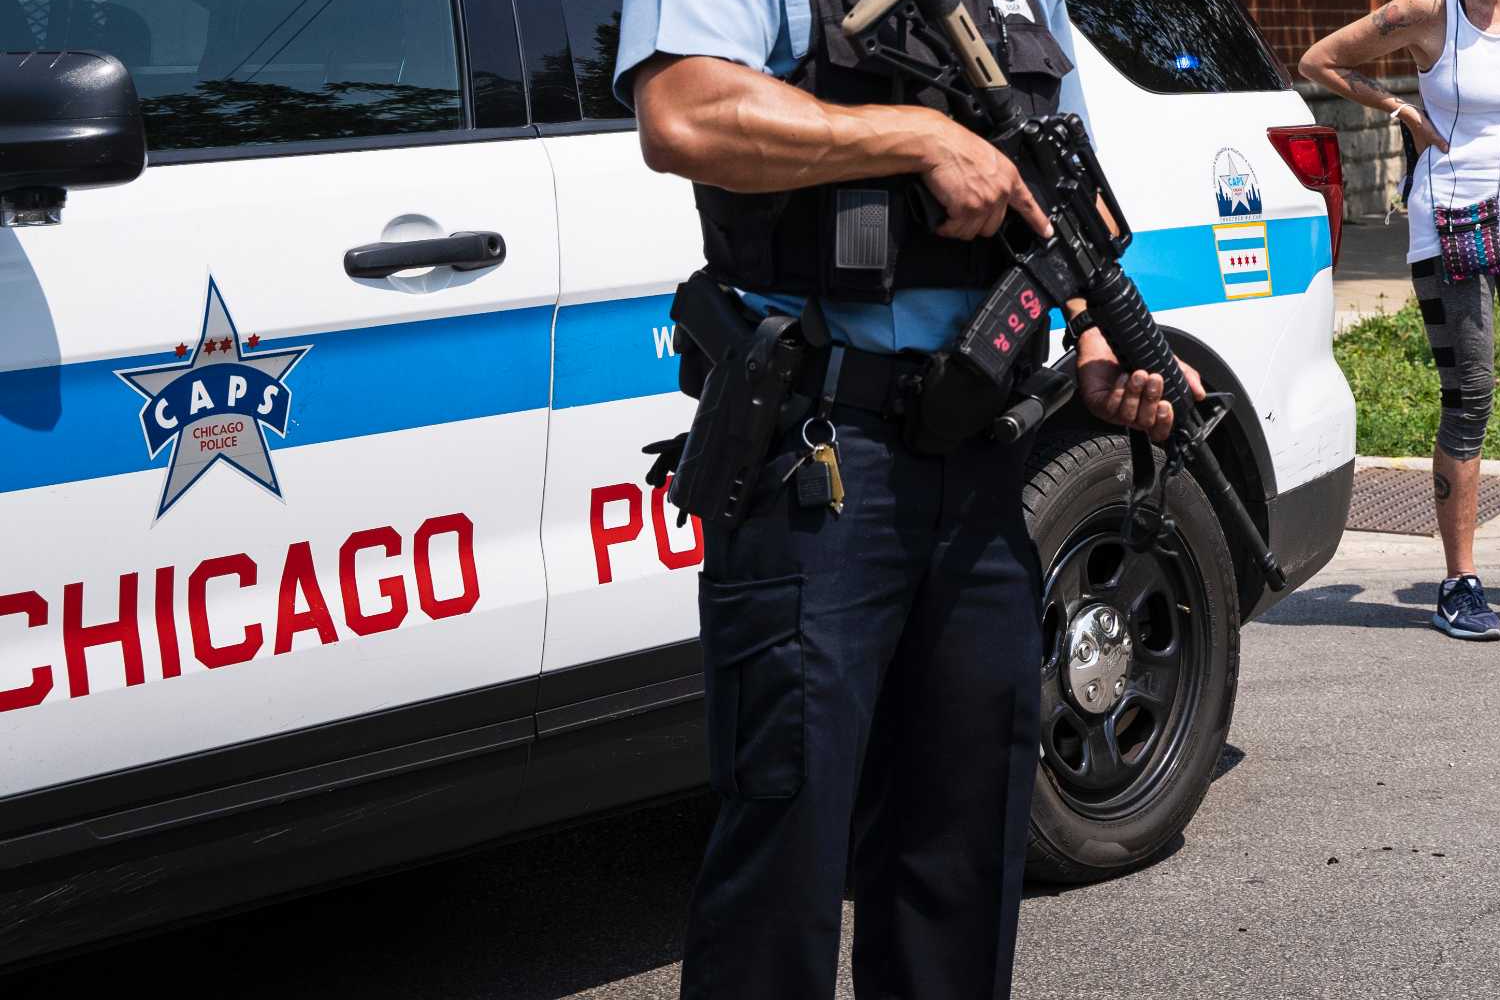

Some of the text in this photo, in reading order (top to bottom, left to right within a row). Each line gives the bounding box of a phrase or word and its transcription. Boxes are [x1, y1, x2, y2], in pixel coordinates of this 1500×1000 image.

[1227, 176, 1245, 187] CAPS
[154, 375, 280, 430] CAPS
[192, 421, 244, 440] CHICAGO
[200, 436, 238, 452] POLICE
[0, 511, 481, 713] CHICAGO
